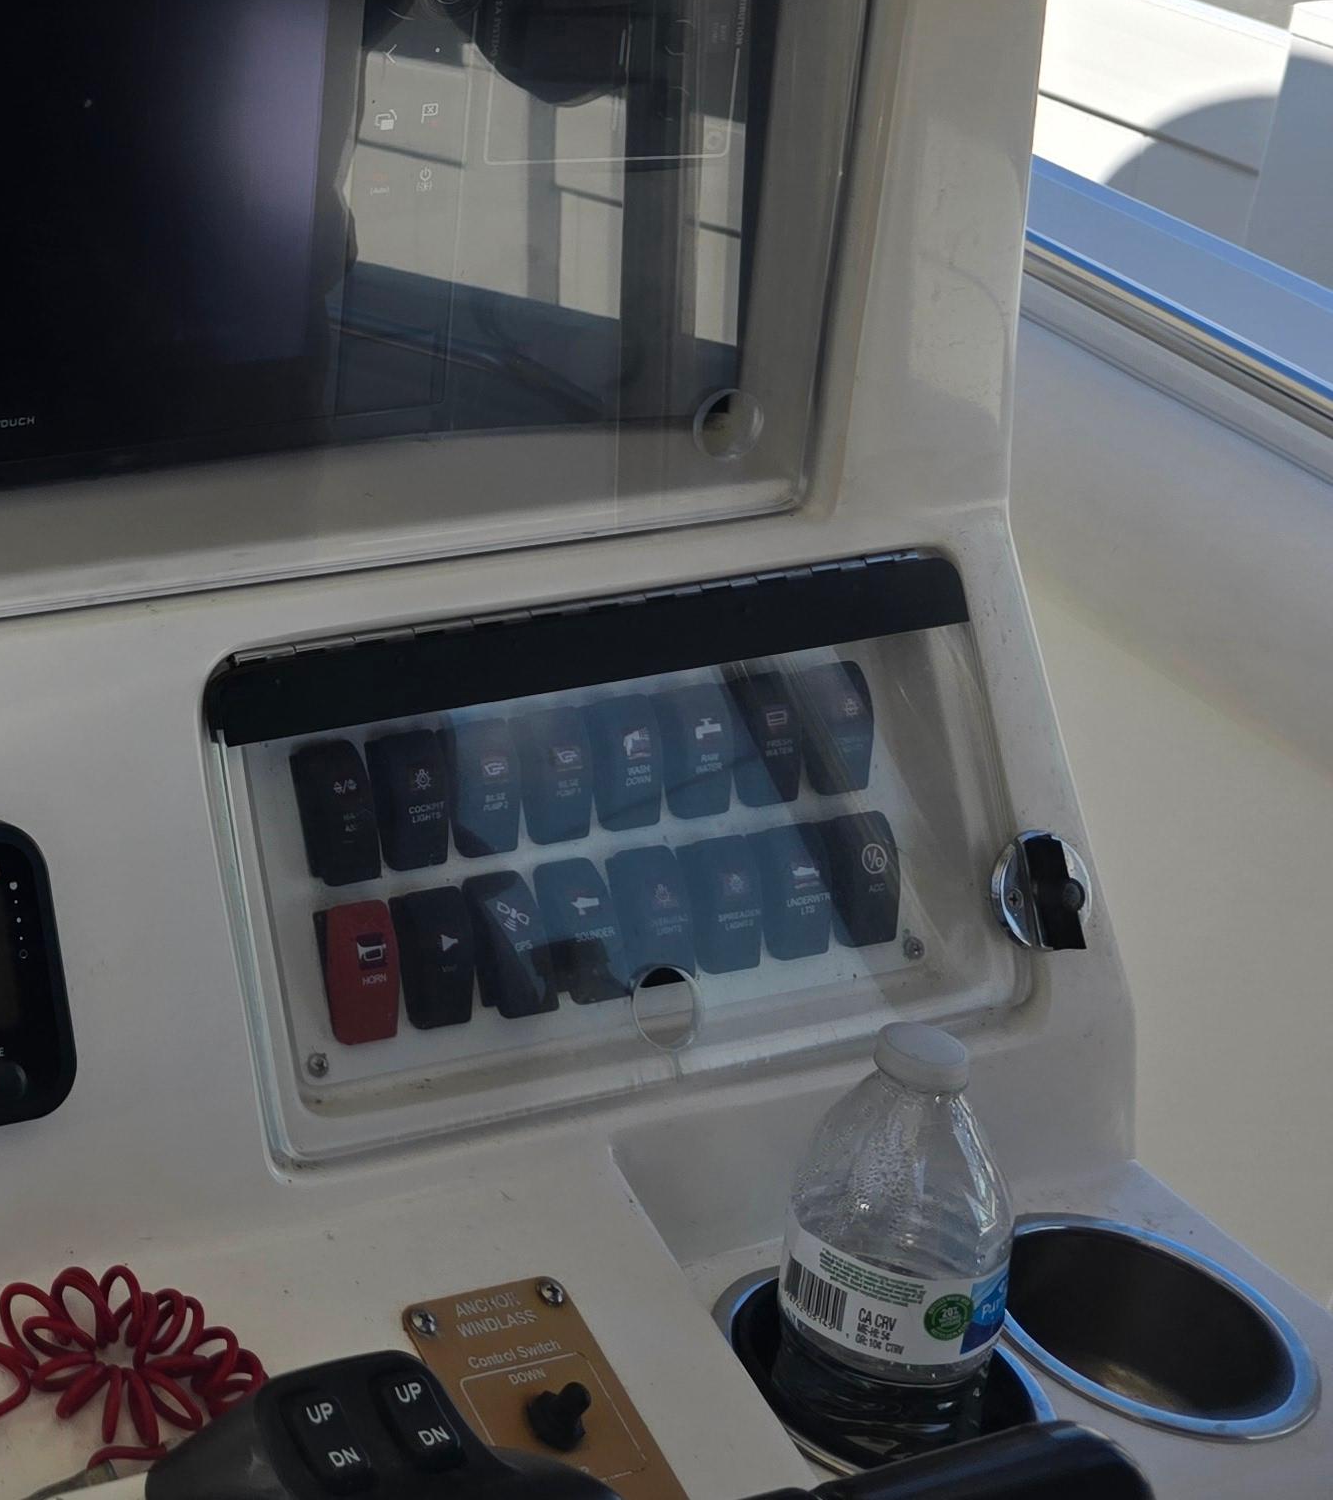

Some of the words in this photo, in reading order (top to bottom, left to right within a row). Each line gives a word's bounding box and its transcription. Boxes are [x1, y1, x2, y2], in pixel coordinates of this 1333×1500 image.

[408, 800, 445, 816] COCKPIT
[411, 811, 443, 824] LIGHTS
[574, 926, 617, 944] SOUNDER
[514, 940, 534, 953] GPS
[361, 972, 387, 986] HORN
[454, 1290, 520, 1318] ANCHOR
[456, 1308, 538, 1339] WINDLASS
[858, 1307, 872, 1326] CA
[874, 1312, 897, 1332] CRV
[467, 1347, 517, 1370] Control
[517, 1338, 562, 1360] Switch
[507, 1367, 547, 1387] DOWN
[394, 1381, 423, 1404] UP
[306, 1402, 334, 1425] UP
[418, 1425, 450, 1447] DN
[328, 1447, 361, 1469] DN
